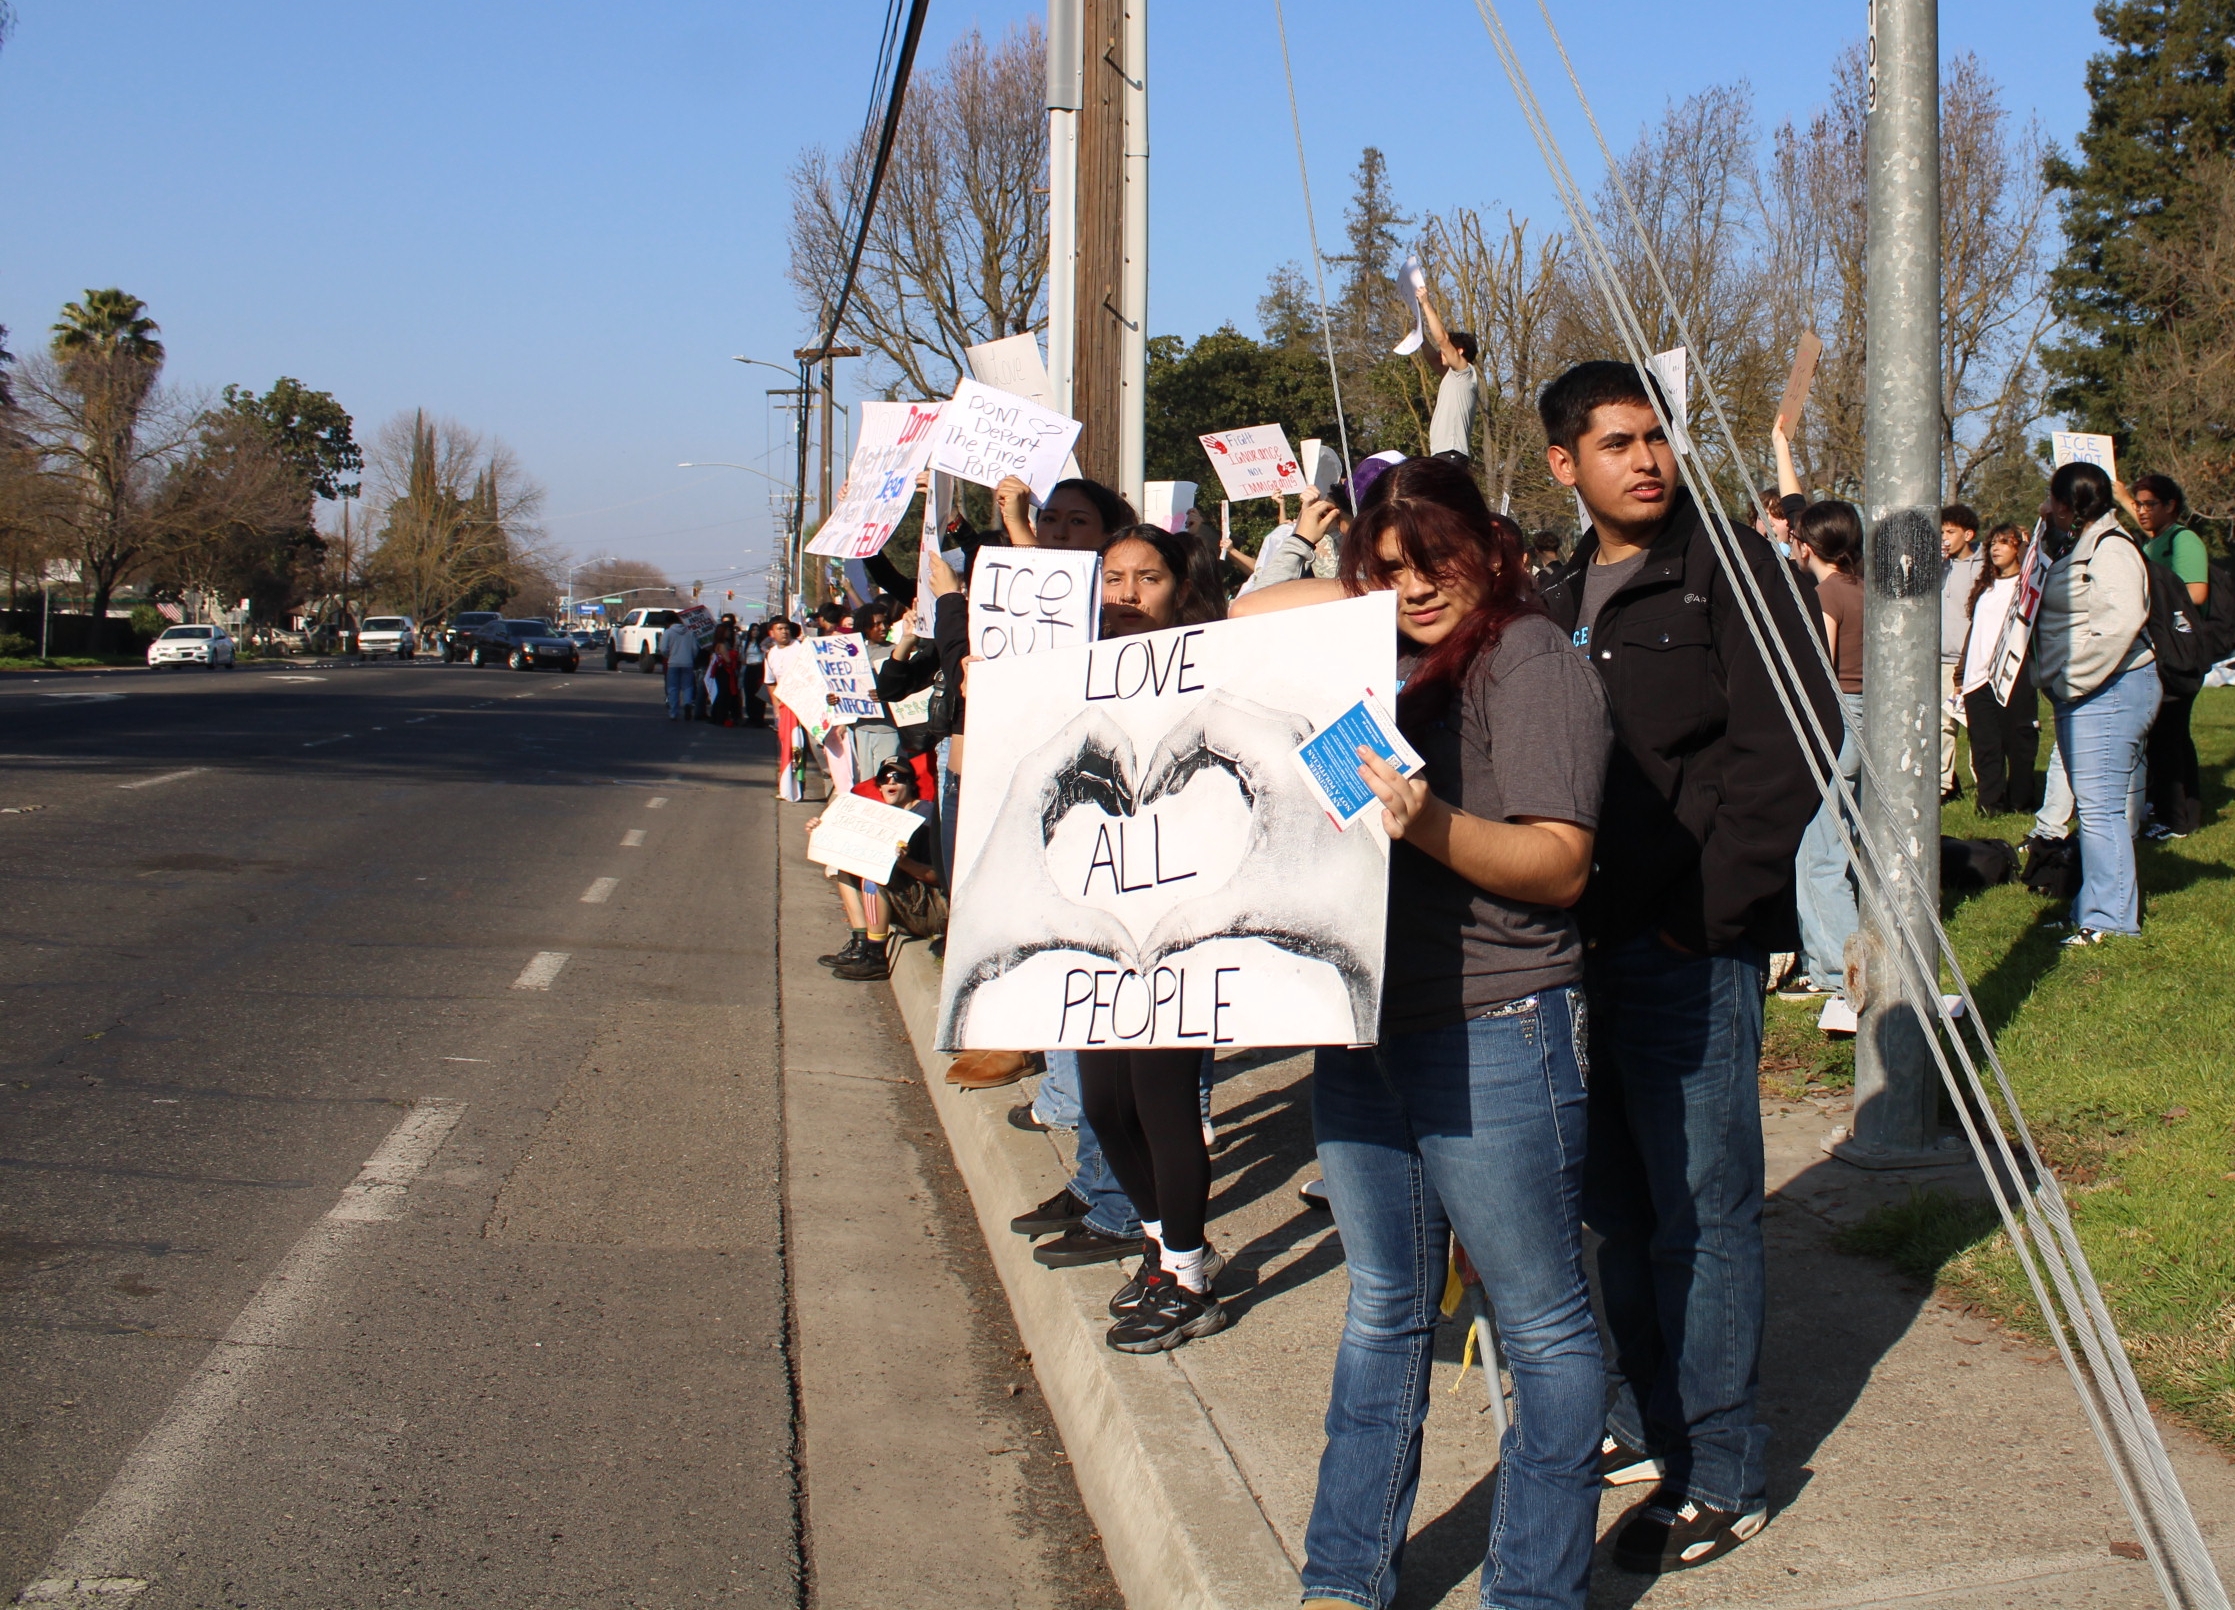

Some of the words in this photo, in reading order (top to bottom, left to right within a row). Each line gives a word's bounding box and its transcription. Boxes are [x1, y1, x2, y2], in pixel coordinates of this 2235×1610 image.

[968, 395, 1022, 426] DONT
[945, 424, 977, 452] The
[984, 441, 1027, 469] Fine
[2058, 434, 2099, 452] ICE
[812, 640, 835, 655] WE
[980, 614, 1075, 659] OUT
[816, 659, 853, 676] NEED
[1084, 629, 1206, 701] LOVE
[1306, 749, 1337, 789] POLITICIAN
[1331, 796, 1342, 808] AN
[1339, 795, 1352, 812] NOT
[1083, 813, 1198, 896] ALL
[1058, 964, 1241, 1046] PEOPLE
